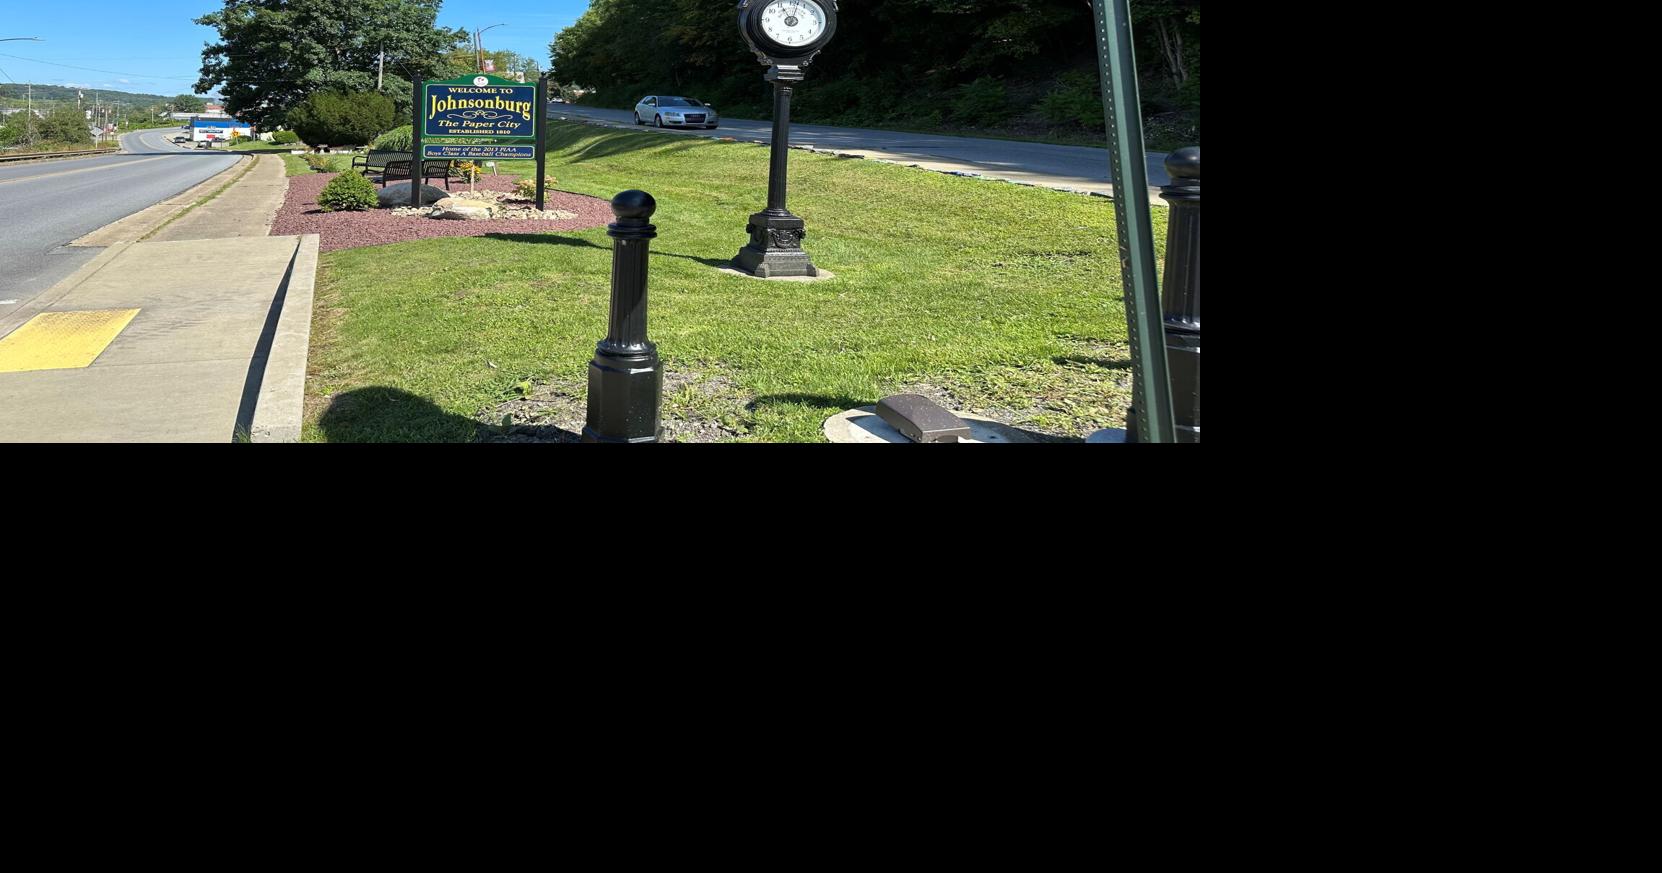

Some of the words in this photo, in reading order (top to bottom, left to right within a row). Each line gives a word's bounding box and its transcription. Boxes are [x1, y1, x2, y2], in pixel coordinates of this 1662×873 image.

[429, 94, 531, 121] Johnsonburg
[462, 120, 495, 129] Paper
[497, 121, 521, 129] City
